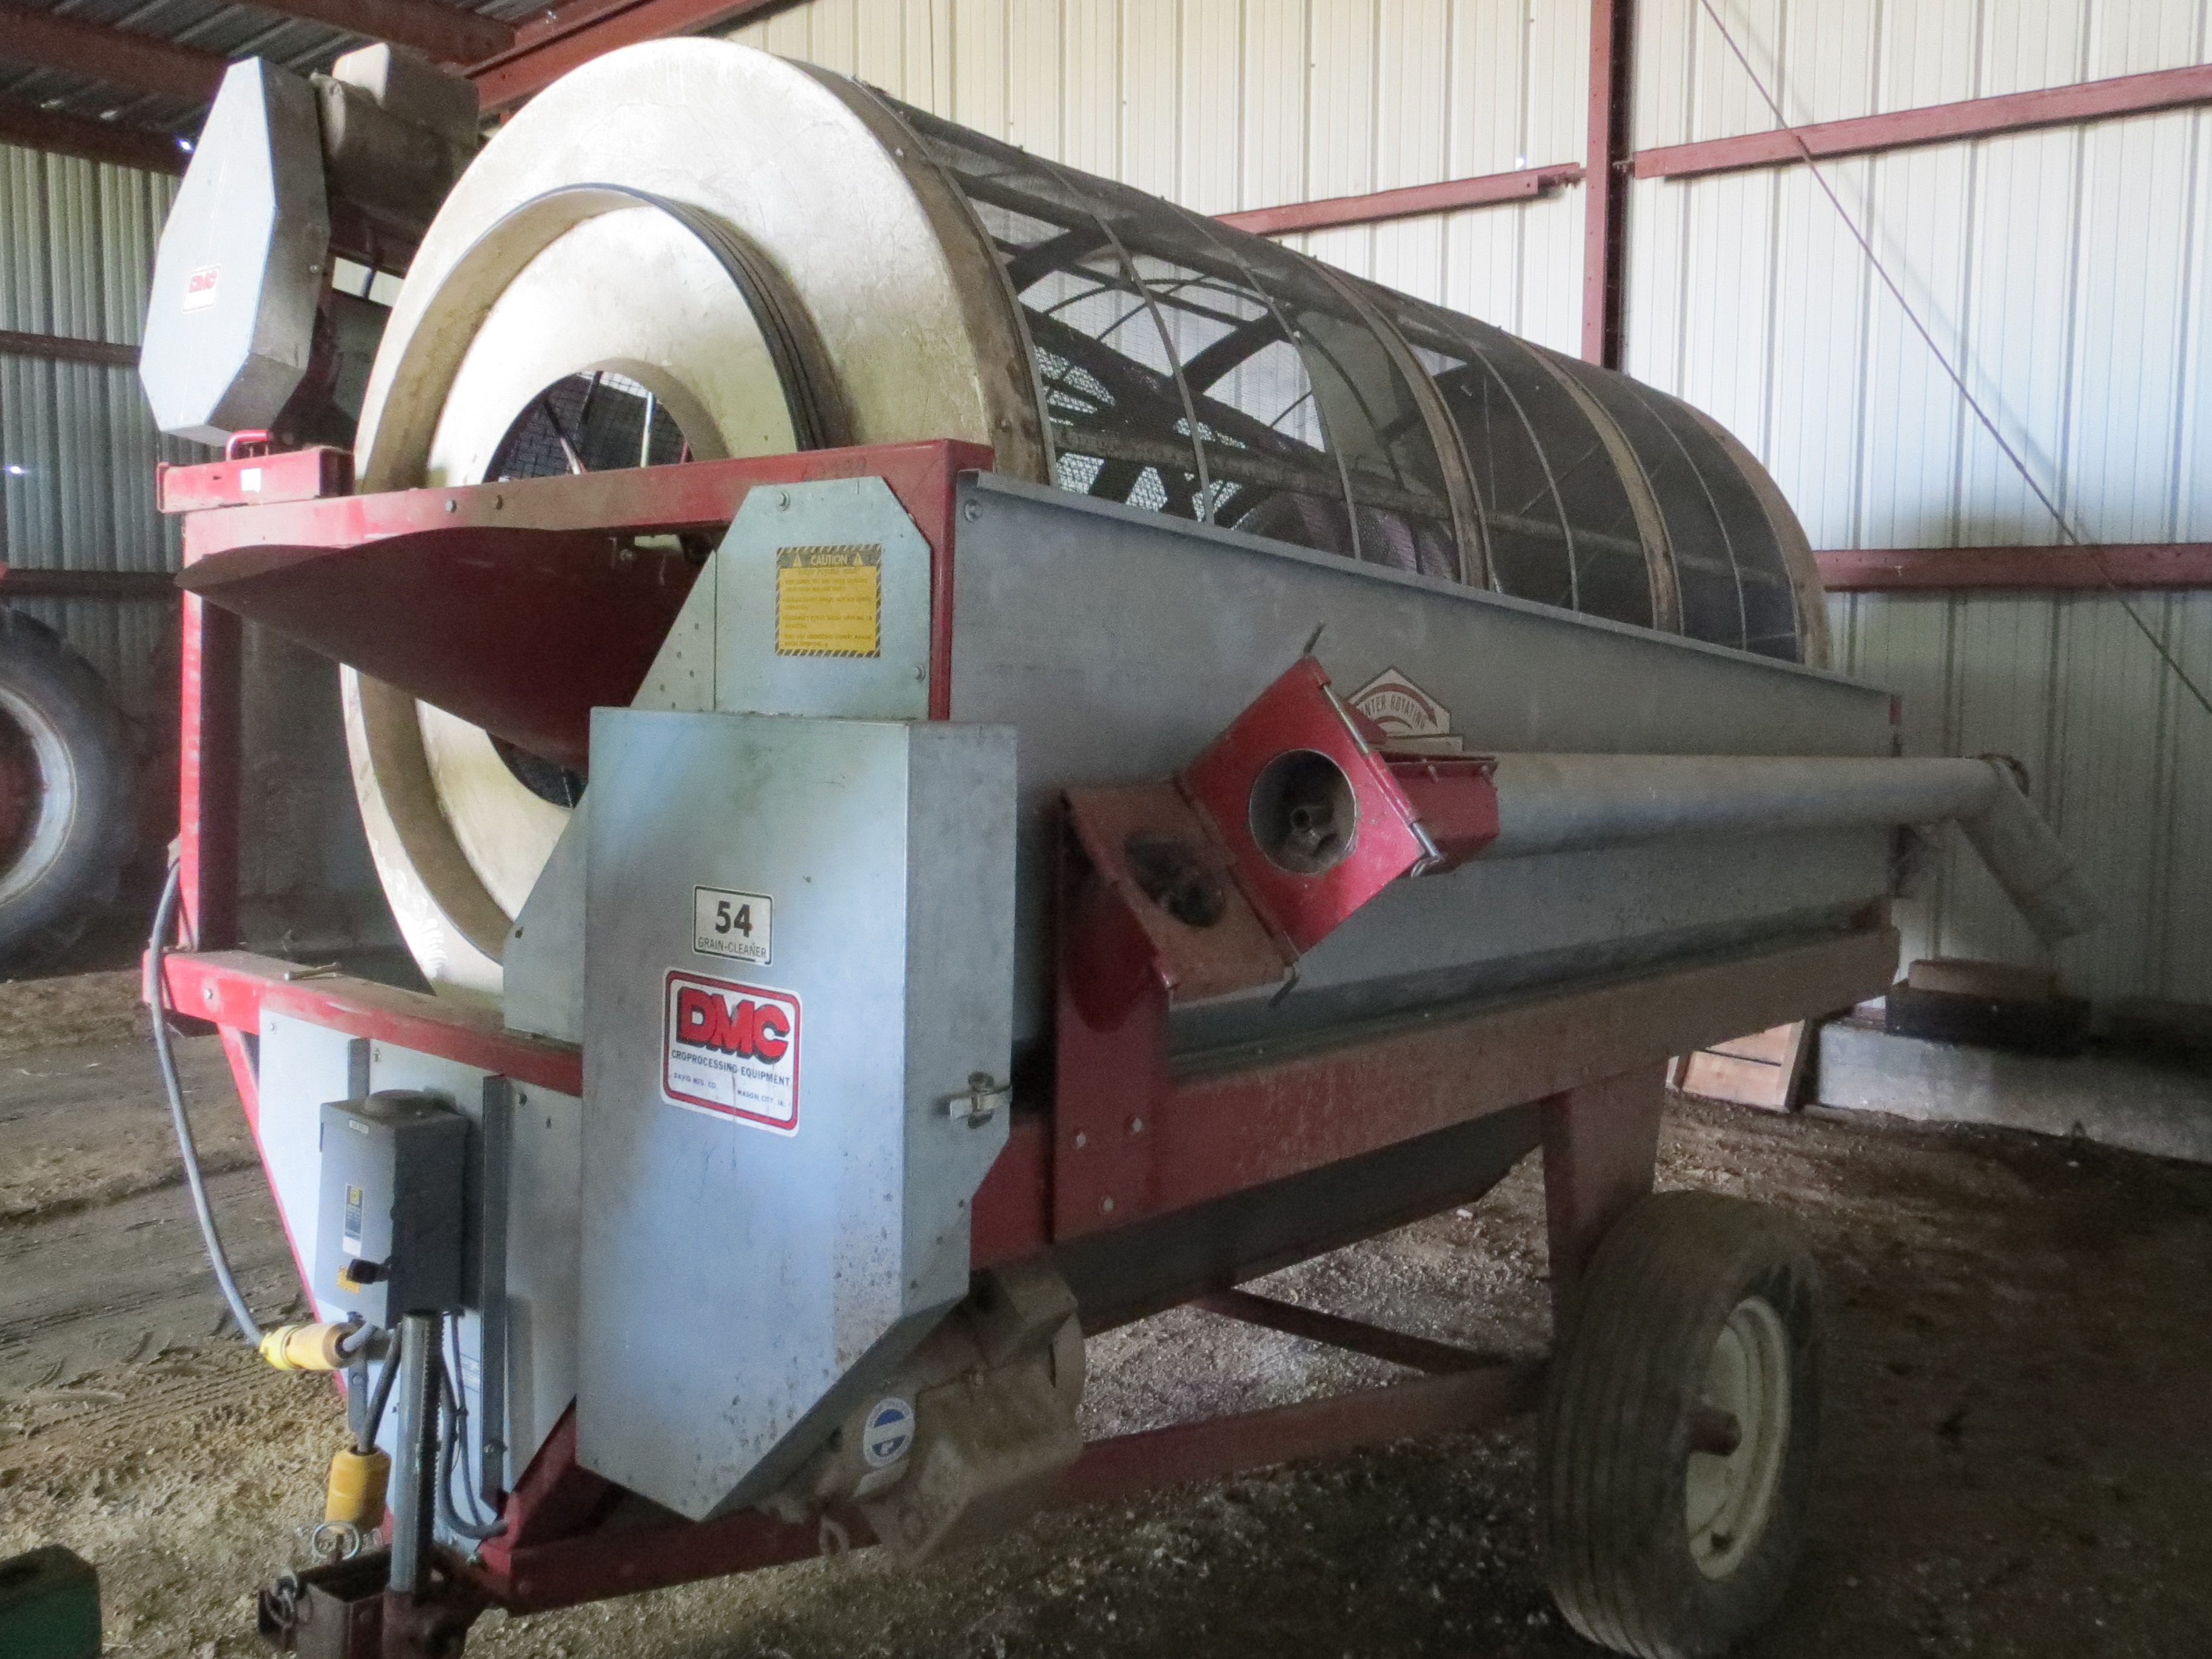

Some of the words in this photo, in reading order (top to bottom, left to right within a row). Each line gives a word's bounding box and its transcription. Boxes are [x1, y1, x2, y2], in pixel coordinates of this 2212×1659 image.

[811, 554, 848, 565] CAUTION
[1360, 695, 1387, 717] NTER
[716, 900, 754, 937] 54
[698, 937, 766, 958] GRAIN-CLEANER
[676, 987, 791, 1065] DMC
[741, 1067, 790, 1087] EQUIPMENT
